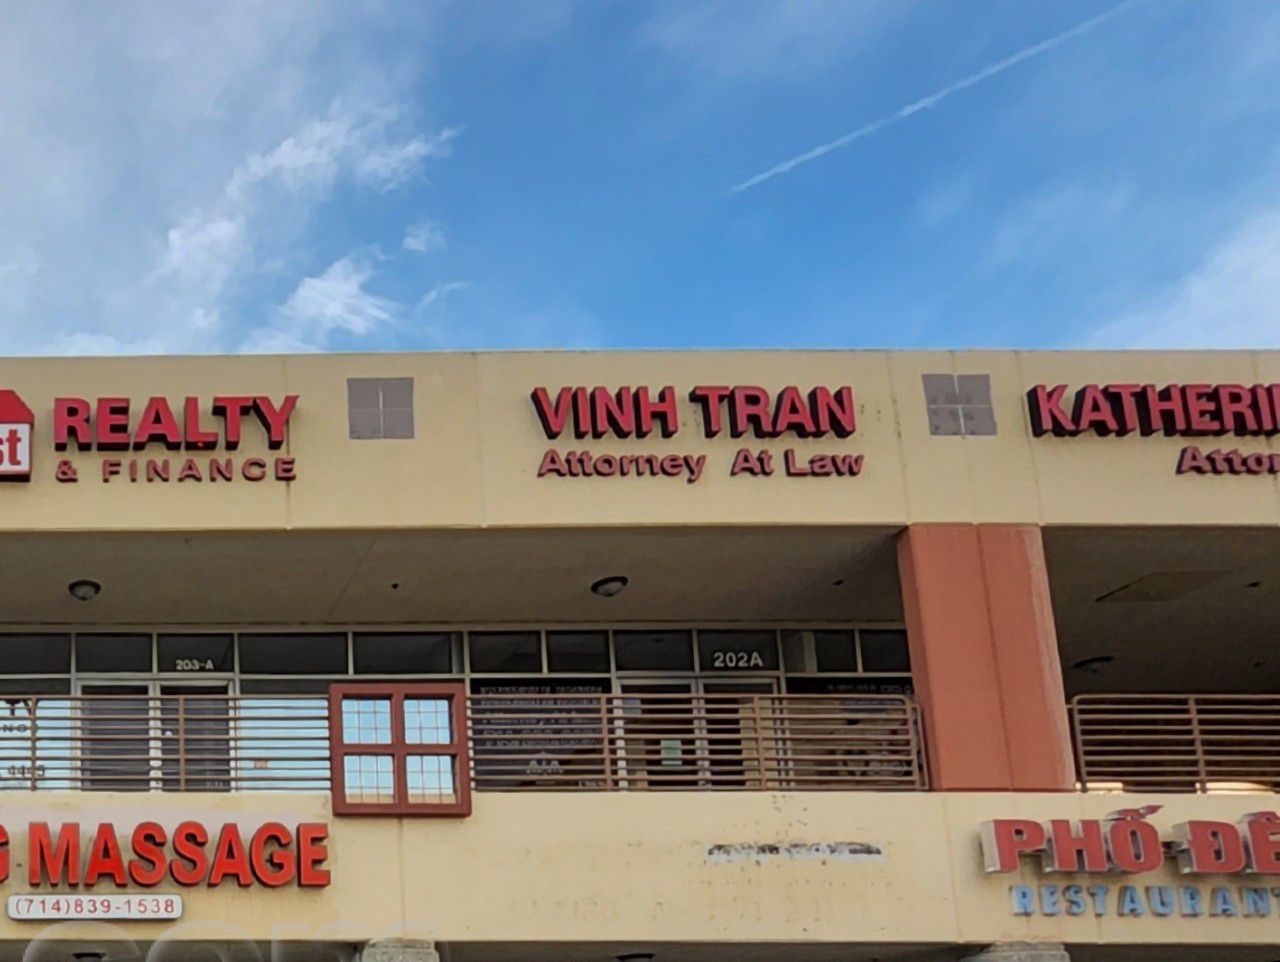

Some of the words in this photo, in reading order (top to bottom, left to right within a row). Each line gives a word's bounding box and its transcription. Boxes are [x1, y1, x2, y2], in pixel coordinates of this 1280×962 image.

[54, 395, 300, 452] REALTY
[531, 386, 679, 440] VINH
[689, 386, 857, 440] TRAN
[55, 459, 79, 483] &
[102, 457, 297, 483] FINANCE
[537, 448, 707, 484] Attorney
[730, 448, 774, 477] At
[784, 448, 865, 477] Law
[713, 651, 765, 669] 202A
[28, 820, 332, 887] MASSAGE
[14, 898, 176, 915] (714)839-1538
